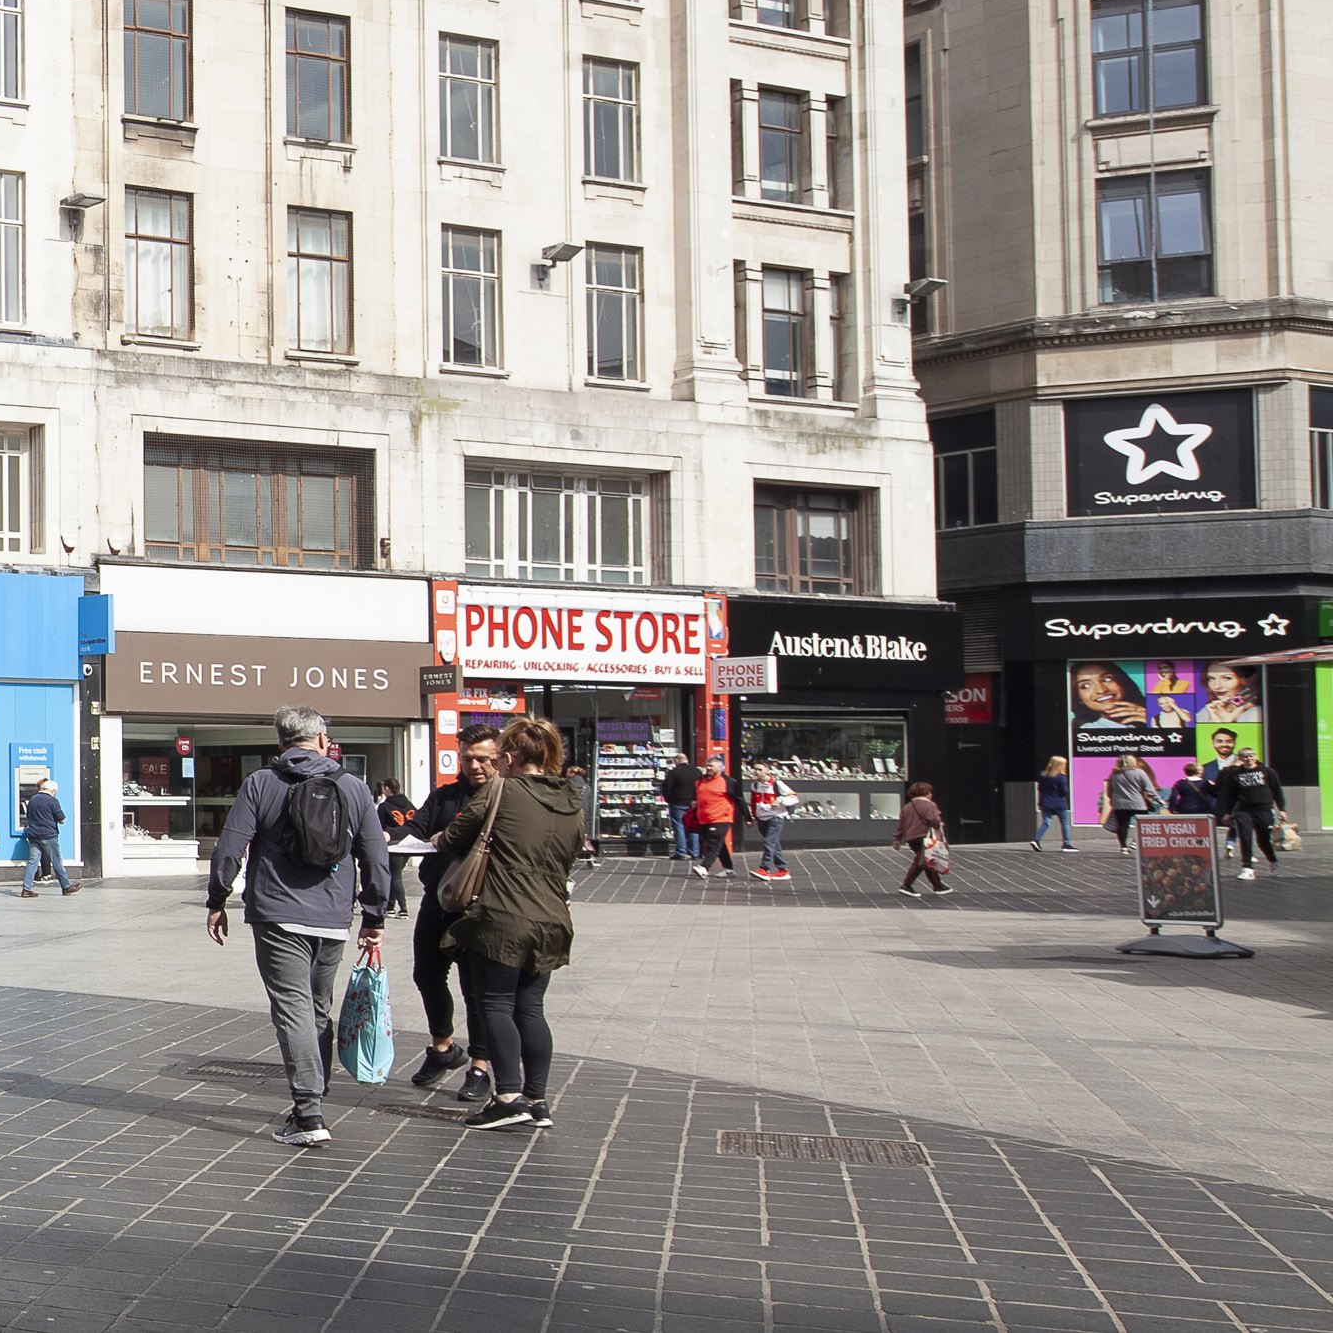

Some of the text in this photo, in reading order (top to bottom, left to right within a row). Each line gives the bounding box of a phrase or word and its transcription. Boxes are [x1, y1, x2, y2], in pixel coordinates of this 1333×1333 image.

[1094, 489, 1225, 506] Superdrug
[465, 605, 701, 655] PHONE STORE
[1044, 617, 1247, 640] Superdrug
[465, 659, 516, 670] REPAIRING
[524, 661, 580, 673] UNLOCKING
[586, 663, 647, 674] ACCESSORIES
[654, 665, 673, 675] BUY
[684, 666, 703, 676] SELL
[718, 664, 764, 676] PHONE
[140, 662, 389, 690] ERNEST JONES
[423, 672, 453, 680] ERNEST
[718, 676, 764, 688] STORE
[1077, 733, 1164, 743] Superdrug
[18, 746, 32, 754] Free
[143, 763, 167, 775] SALE
[1140, 823, 1196, 835] FREE VEGAN
[1141, 837, 1167, 847] FRIED
